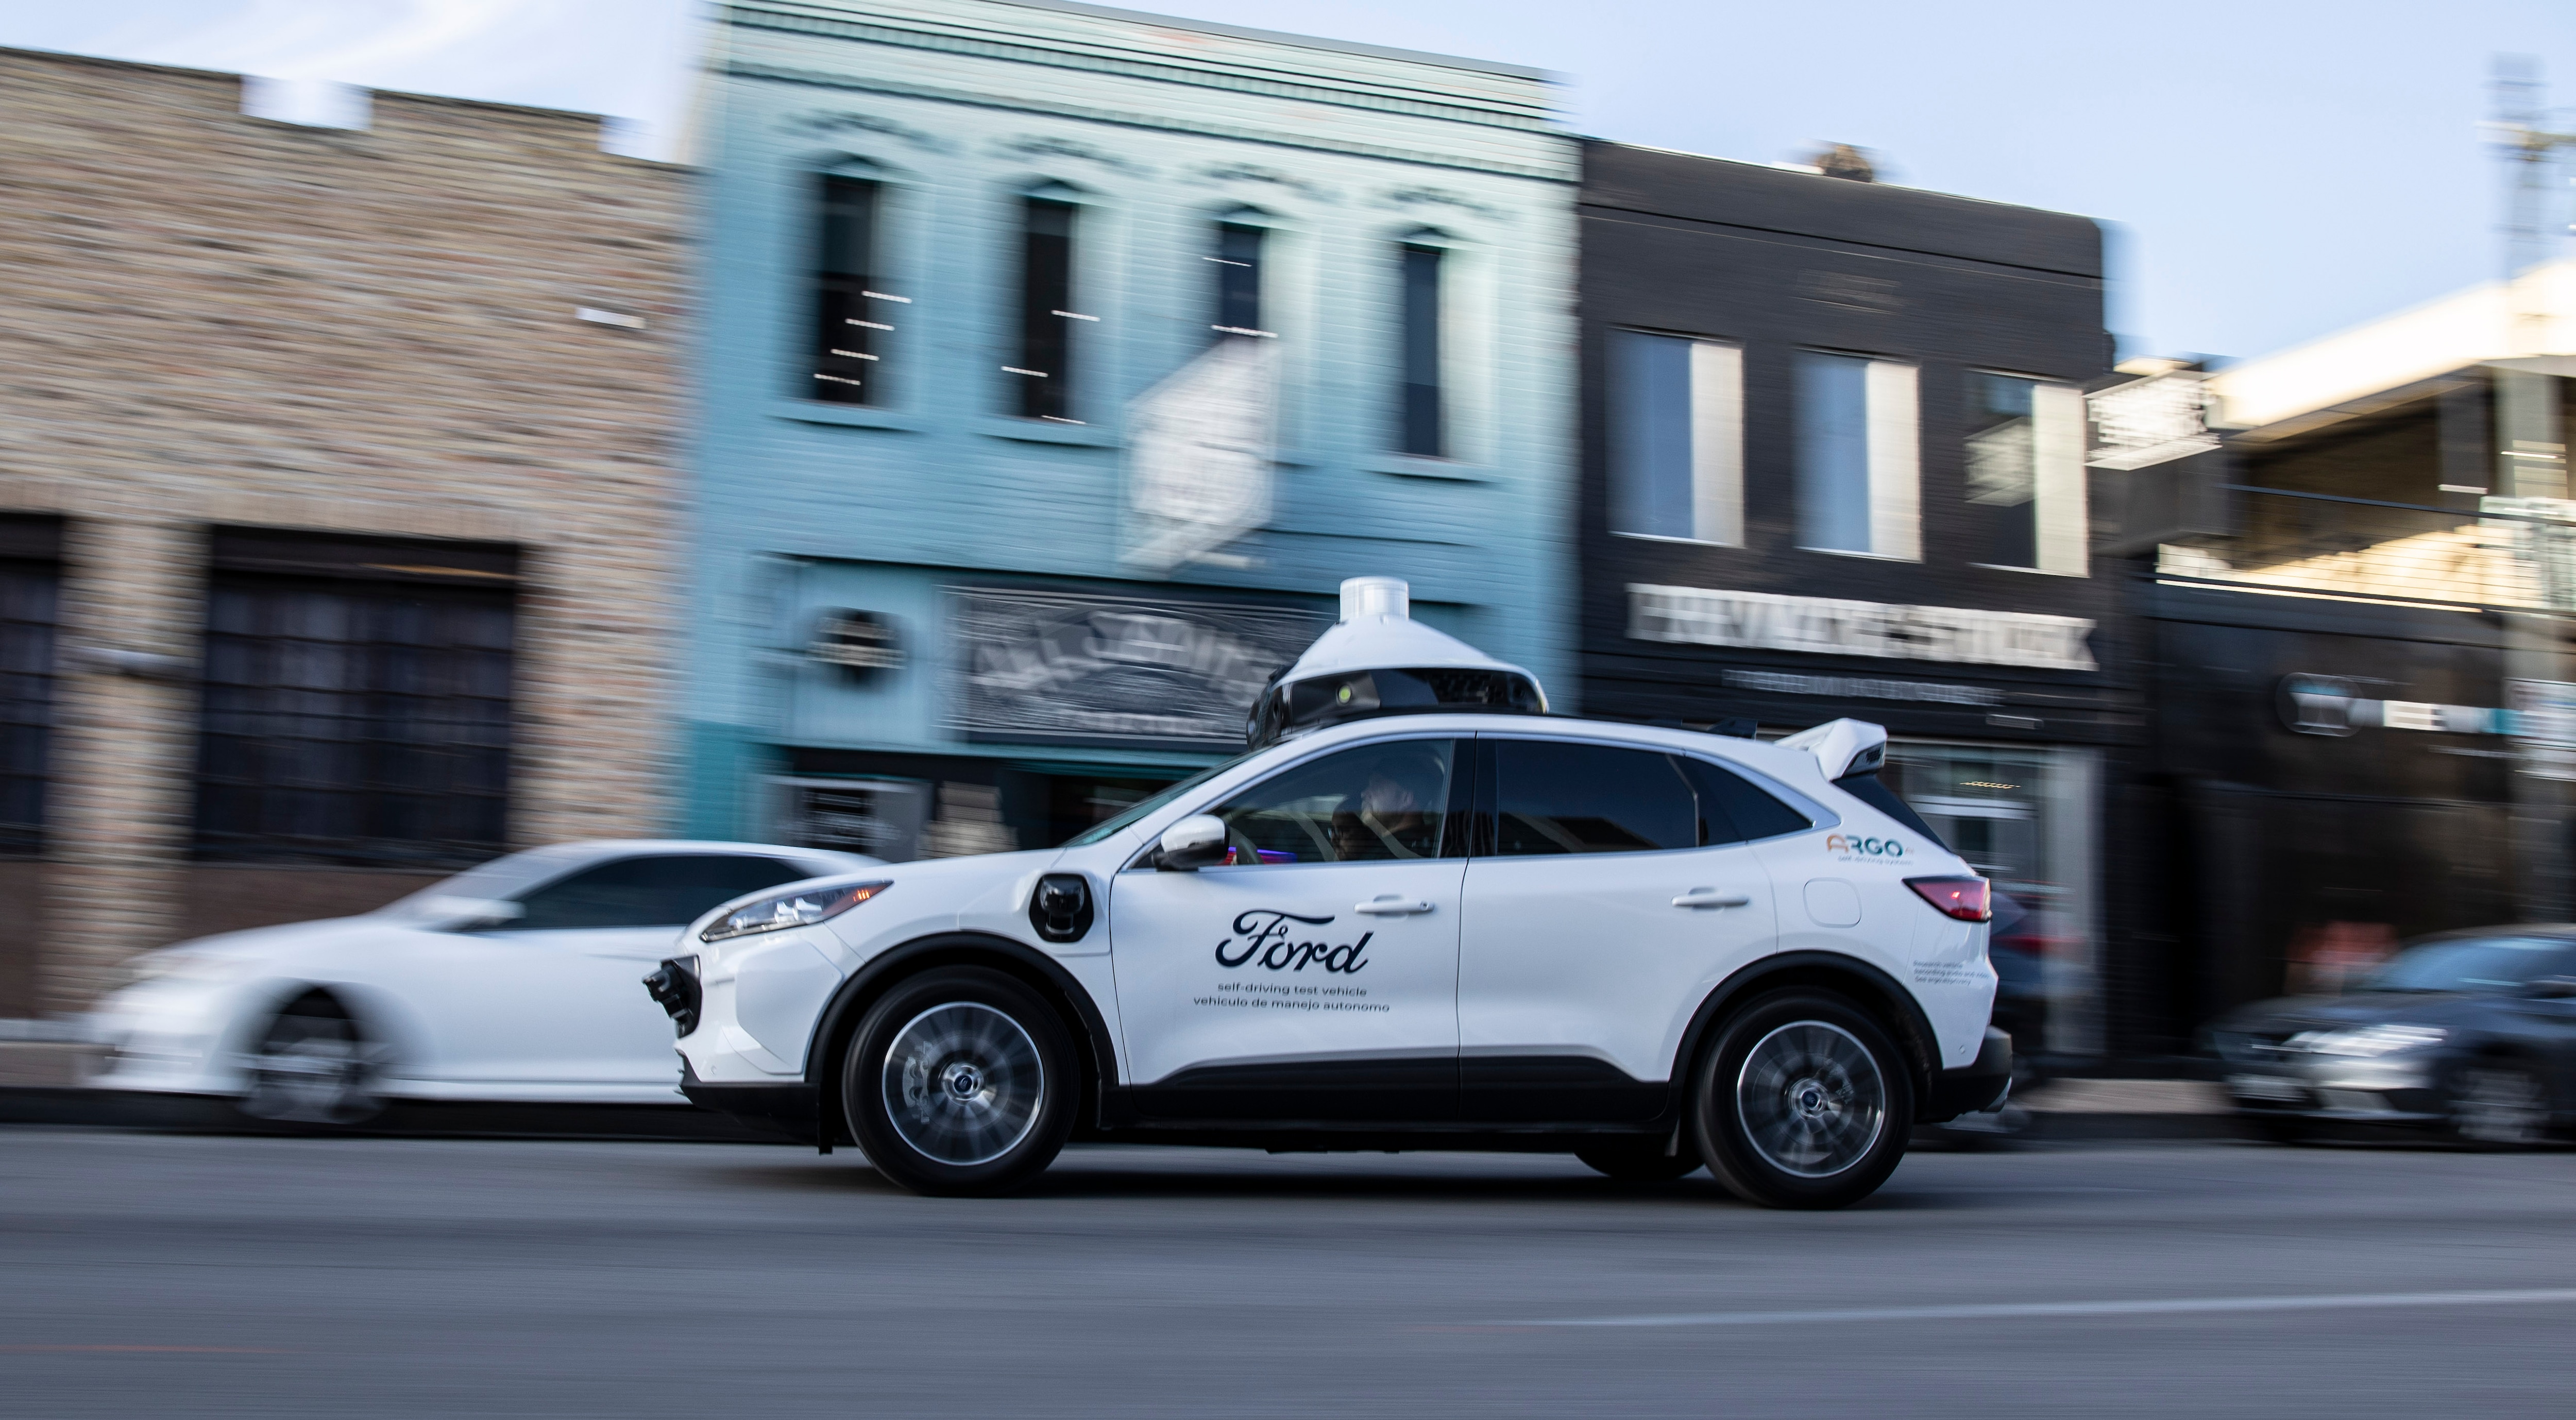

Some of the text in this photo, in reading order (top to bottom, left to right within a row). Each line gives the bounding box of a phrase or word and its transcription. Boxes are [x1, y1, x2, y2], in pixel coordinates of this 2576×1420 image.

[1826, 834, 1903, 858] ARGO
[1215, 908, 1374, 973] Ford
[1217, 982, 1367, 998] self-driving test vehicle
[1193, 996, 1390, 1014] vehiculo de manejo autonomo
